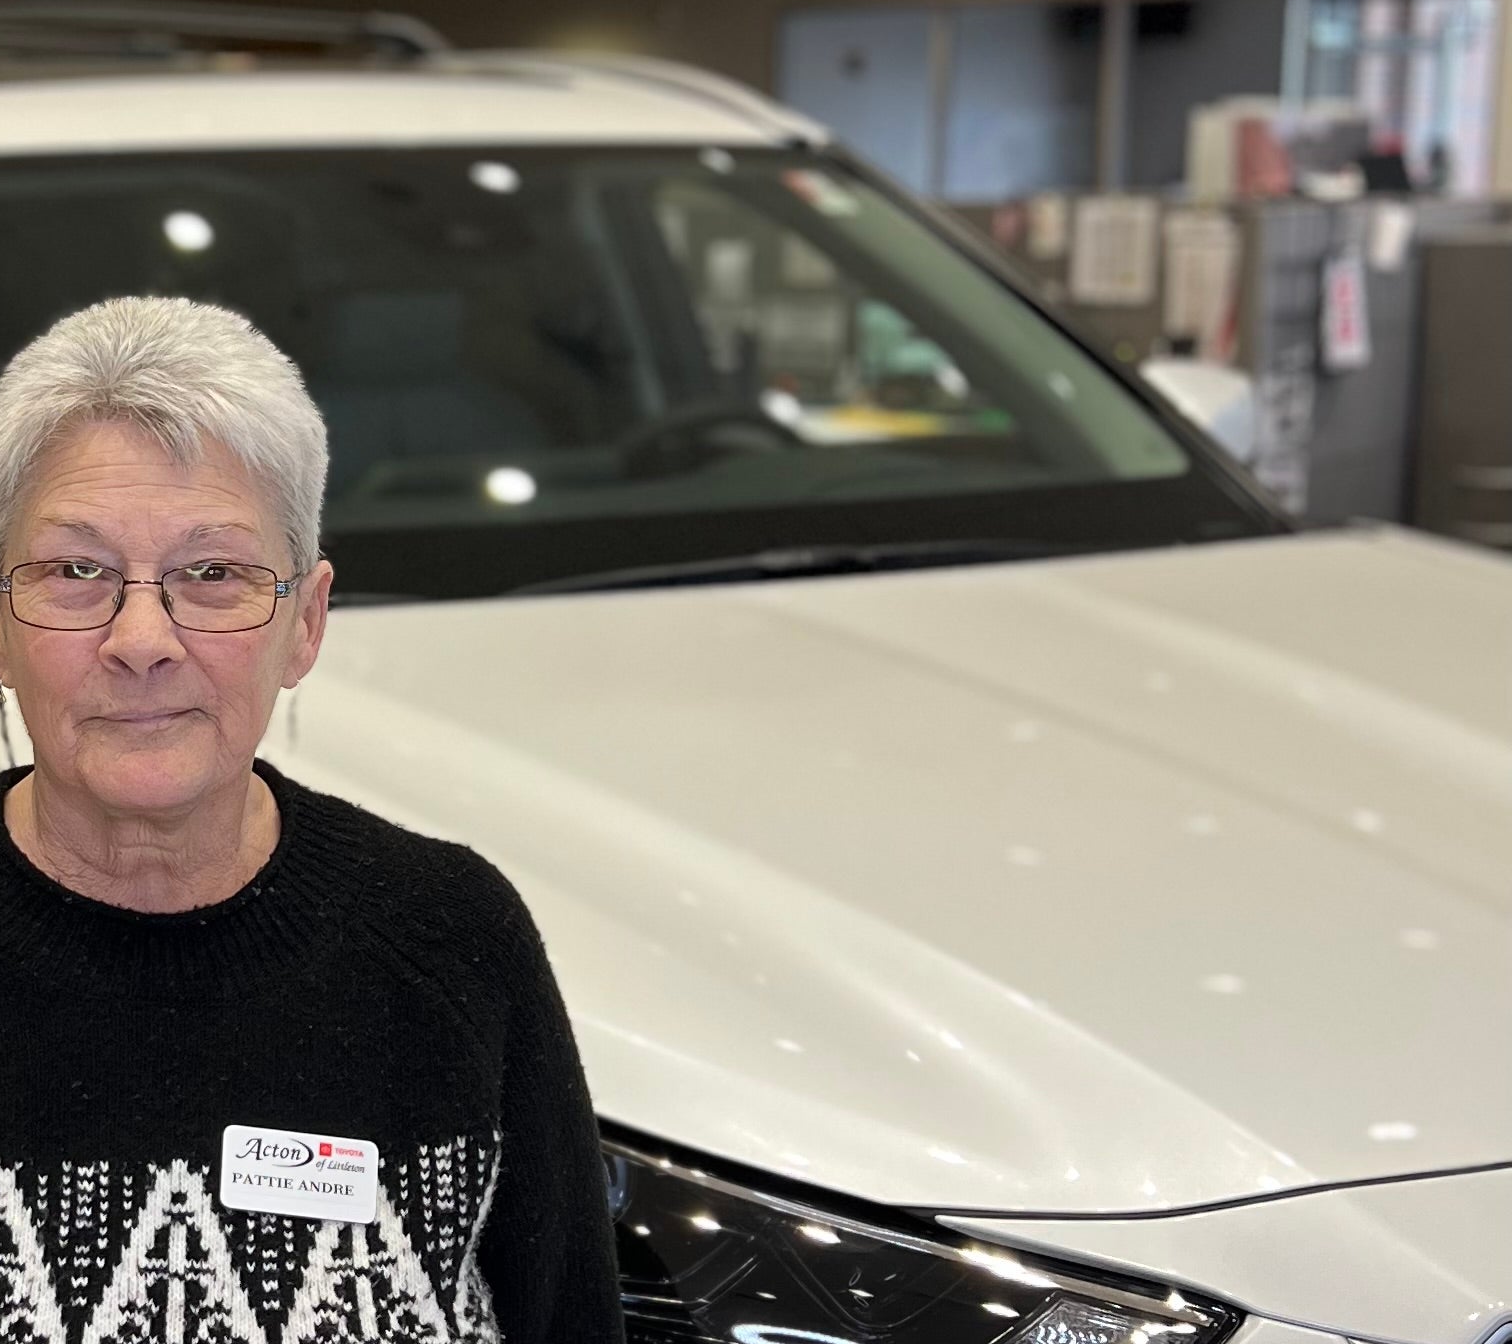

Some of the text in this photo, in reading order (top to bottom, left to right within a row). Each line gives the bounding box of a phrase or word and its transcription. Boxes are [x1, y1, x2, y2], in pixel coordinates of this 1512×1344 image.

[235, 1138, 302, 1160] Acton
[335, 1147, 364, 1157] TOYOTA
[315, 1159, 365, 1173] of Littleton
[232, 1172, 354, 1196] PATTIE ANDRE
